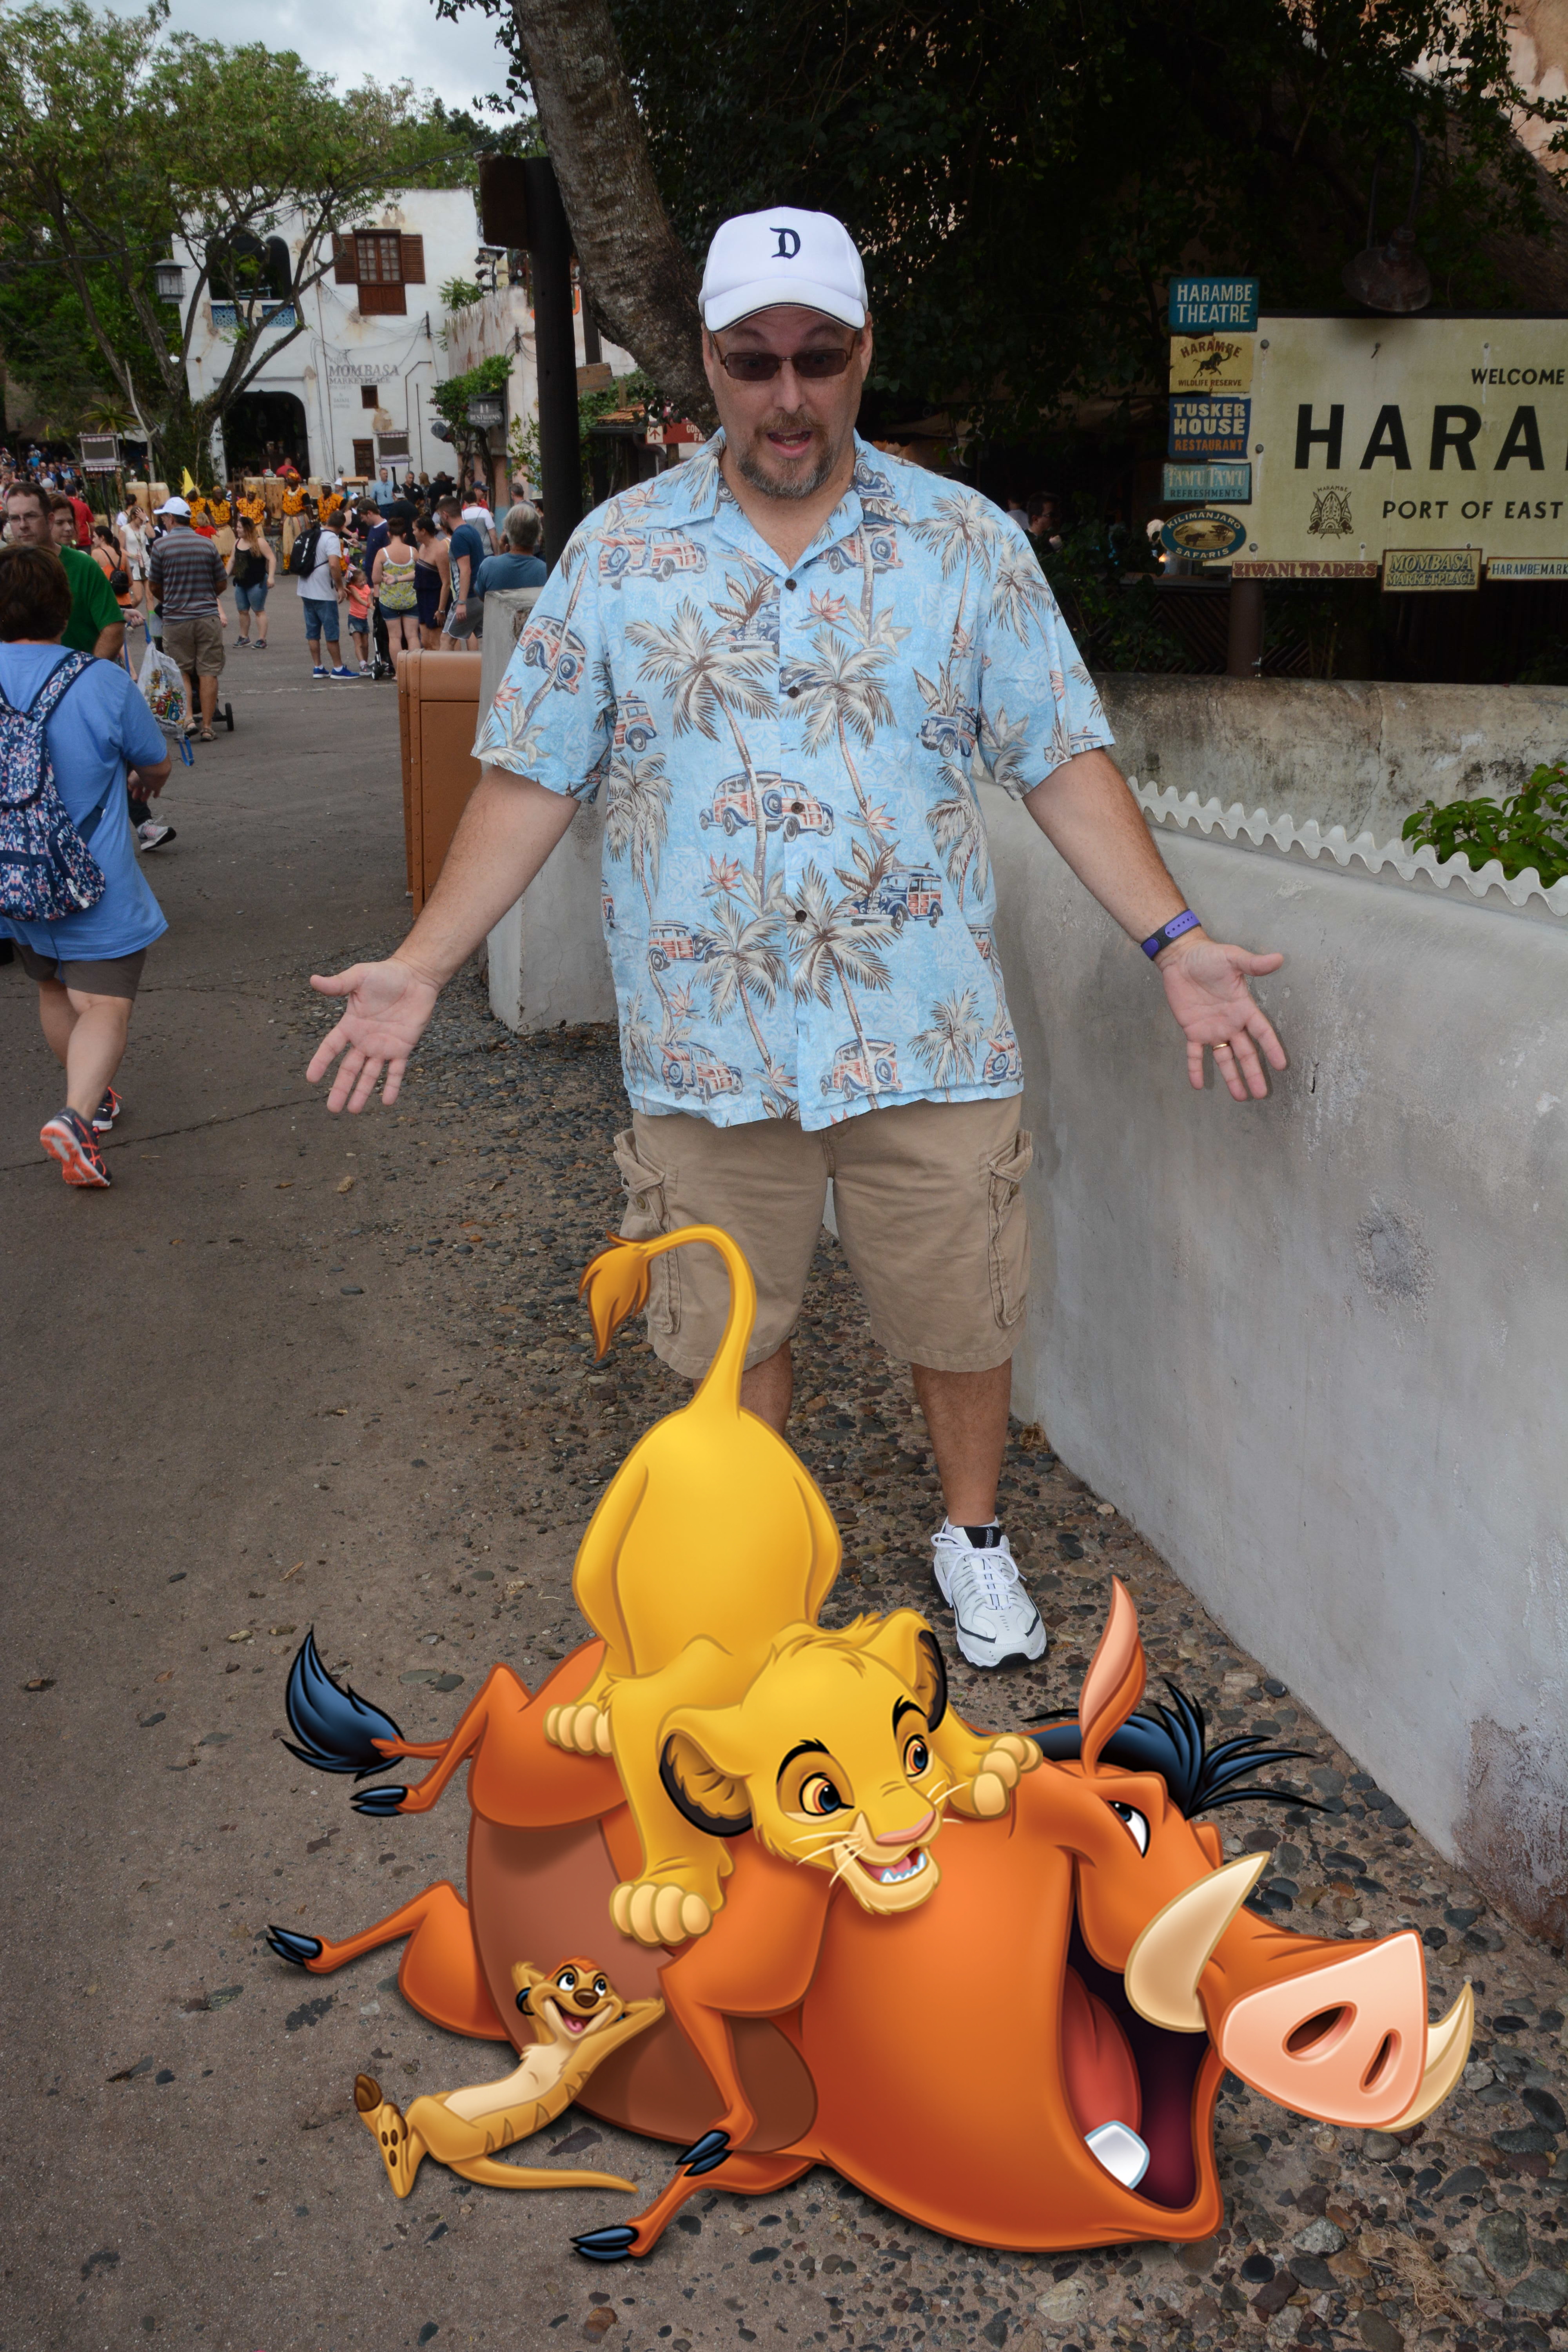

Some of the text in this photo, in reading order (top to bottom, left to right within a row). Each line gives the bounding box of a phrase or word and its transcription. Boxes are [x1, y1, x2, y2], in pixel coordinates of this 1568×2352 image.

[769, 227, 800, 259] D
[1177, 285, 1252, 301] HARAMBE
[1177, 304, 1250, 323] THEATRE
[1180, 341, 1242, 358] HARAMBE
[328, 364, 400, 377] MOMBASA
[1471, 368, 1565, 385] WELCOME
[1174, 403, 1246, 417] TUSKER
[1174, 419, 1245, 435] HOUSE
[1174, 439, 1243, 450] RESTAURANT
[1295, 404, 1568, 470] HARA
[1170, 489, 1242, 497] REFRESHMENTS
[1383, 501, 1563, 519] PORT OF EAST
[1167, 512, 1241, 529] KILIMANJARO
[1176, 547, 1229, 559] SAFARIS
[1232, 562, 1377, 577] ZIWANI TRADERS
[1389, 554, 1473, 573] MOMBASA
[1386, 572, 1475, 586] MARKETPLACE
[151, 695, 180, 721] 2016
